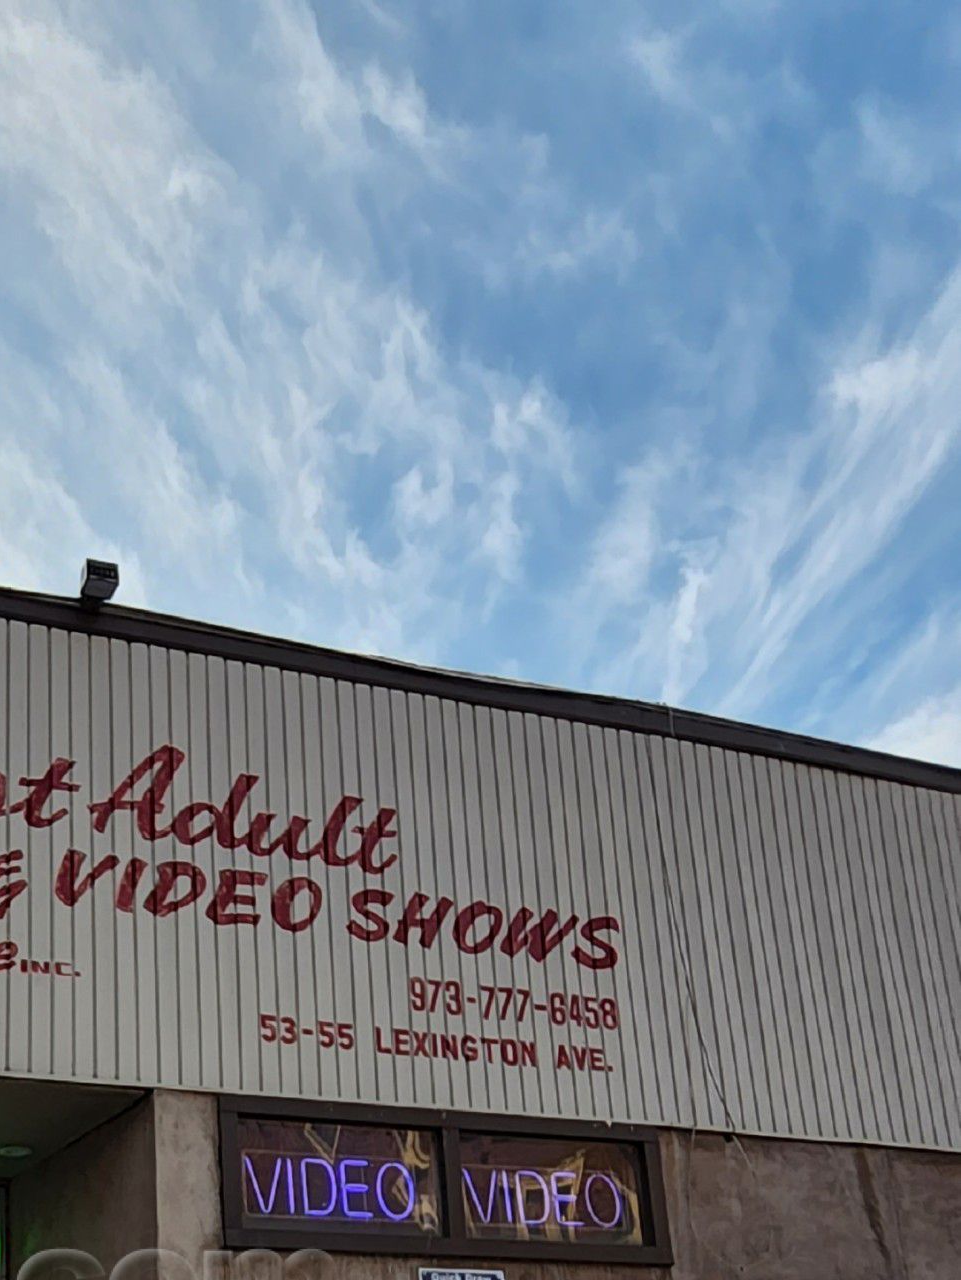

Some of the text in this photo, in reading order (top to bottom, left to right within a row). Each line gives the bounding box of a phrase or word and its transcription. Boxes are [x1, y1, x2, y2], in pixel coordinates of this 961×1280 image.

[88, 744, 398, 876] Adult
[53, 849, 322, 933] VIDEO
[346, 888, 620, 970] SHOWS
[19, 959, 82, 978] INC.
[409, 976, 619, 1031] 973-777-6458
[259, 1014, 614, 1073] 53-55 LEXINGTON AVE.
[244, 1156, 416, 1221] VIDEO
[462, 1168, 623, 1229] VIDEO
